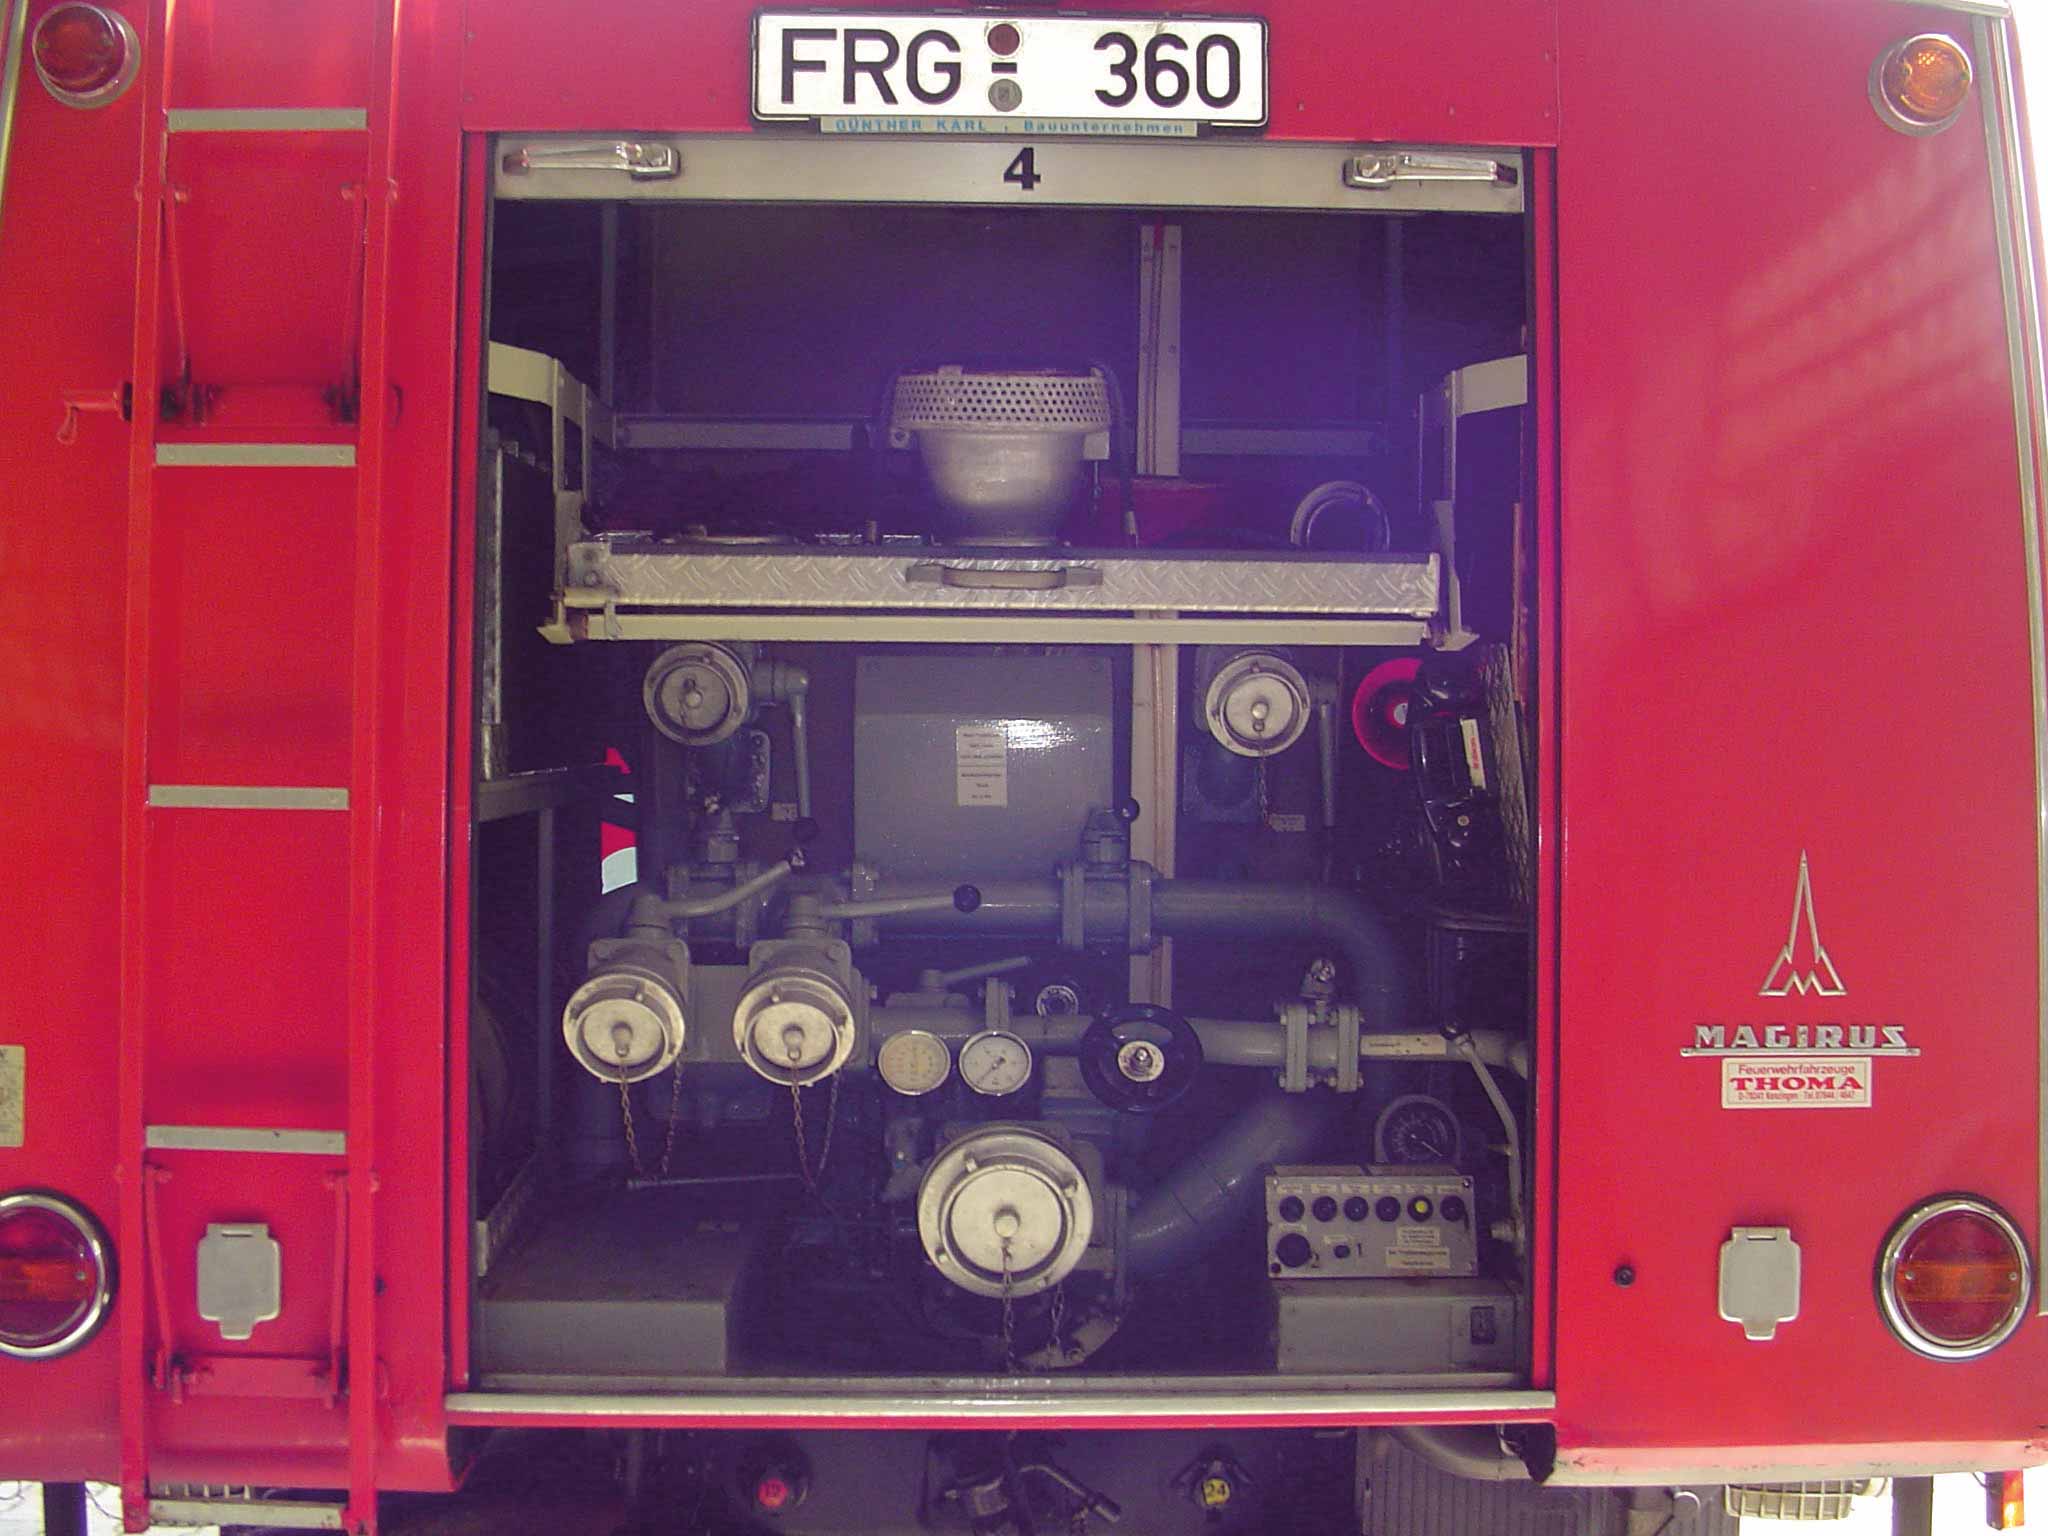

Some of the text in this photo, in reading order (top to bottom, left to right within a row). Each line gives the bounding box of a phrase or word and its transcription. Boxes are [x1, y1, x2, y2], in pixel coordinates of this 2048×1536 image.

[781, 28, 963, 105] FRG
[1093, 31, 1242, 108] 360
[936, 118, 987, 132] KARL
[1023, 119, 1185, 135] Bauunternehmen
[1003, 147, 1042, 191] 4
[1738, 1064, 1856, 1076] Feuerwehrfahrzeuge
[1730, 1077, 1864, 1090] THOMA
[1204, 1482, 1226, 1498] 24
